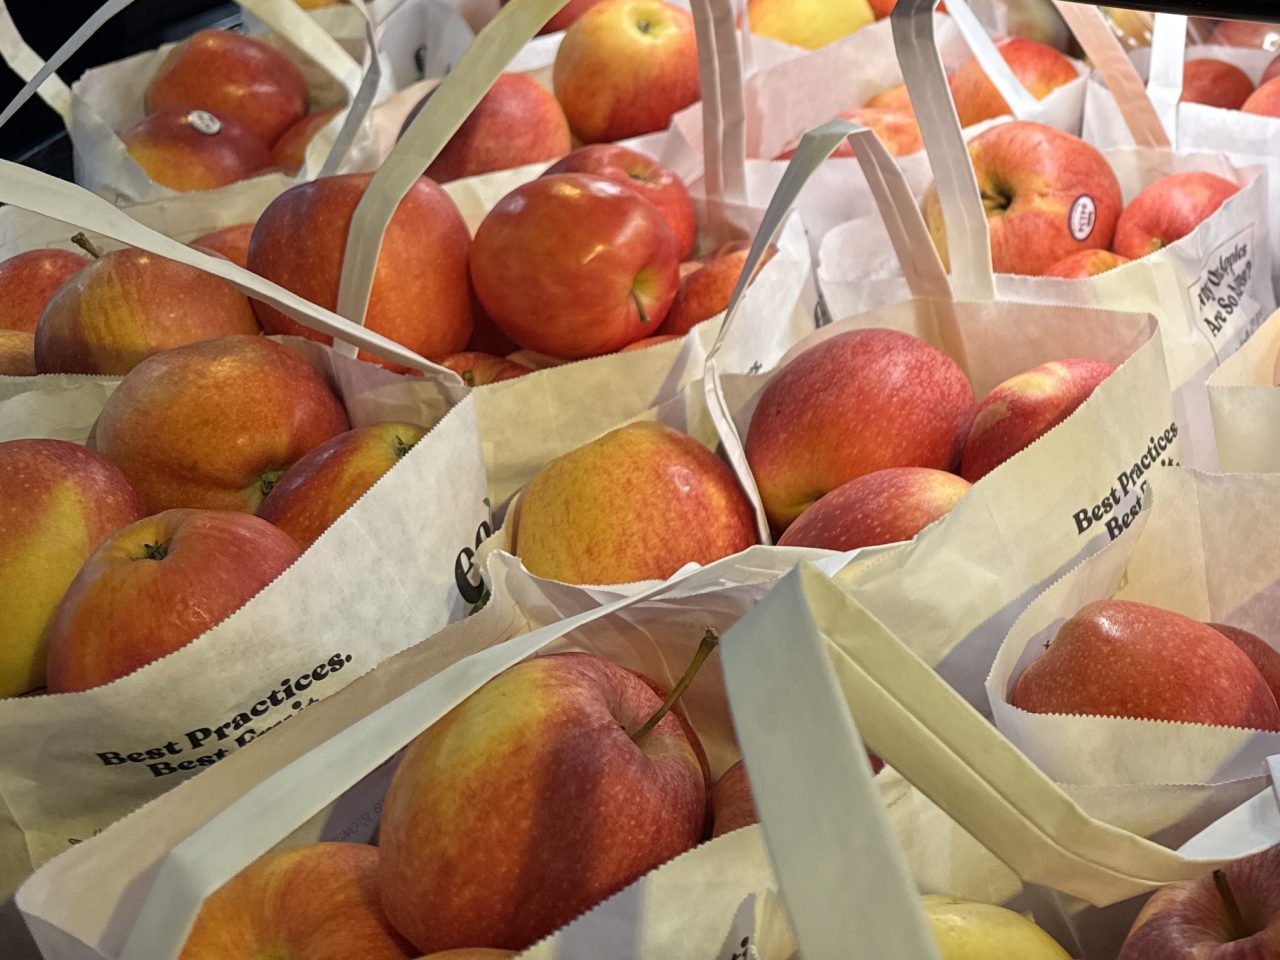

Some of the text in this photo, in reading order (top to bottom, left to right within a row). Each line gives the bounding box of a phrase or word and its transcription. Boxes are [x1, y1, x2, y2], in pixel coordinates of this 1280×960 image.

[1203, 309, 1228, 338] Are
[1217, 293, 1239, 315] So
[1072, 486, 1121, 535] Best
[1105, 494, 1142, 541] Best
[96, 740, 184, 766] Best
[184, 652, 353, 750] Practices.
[146, 747, 230, 778] Best
